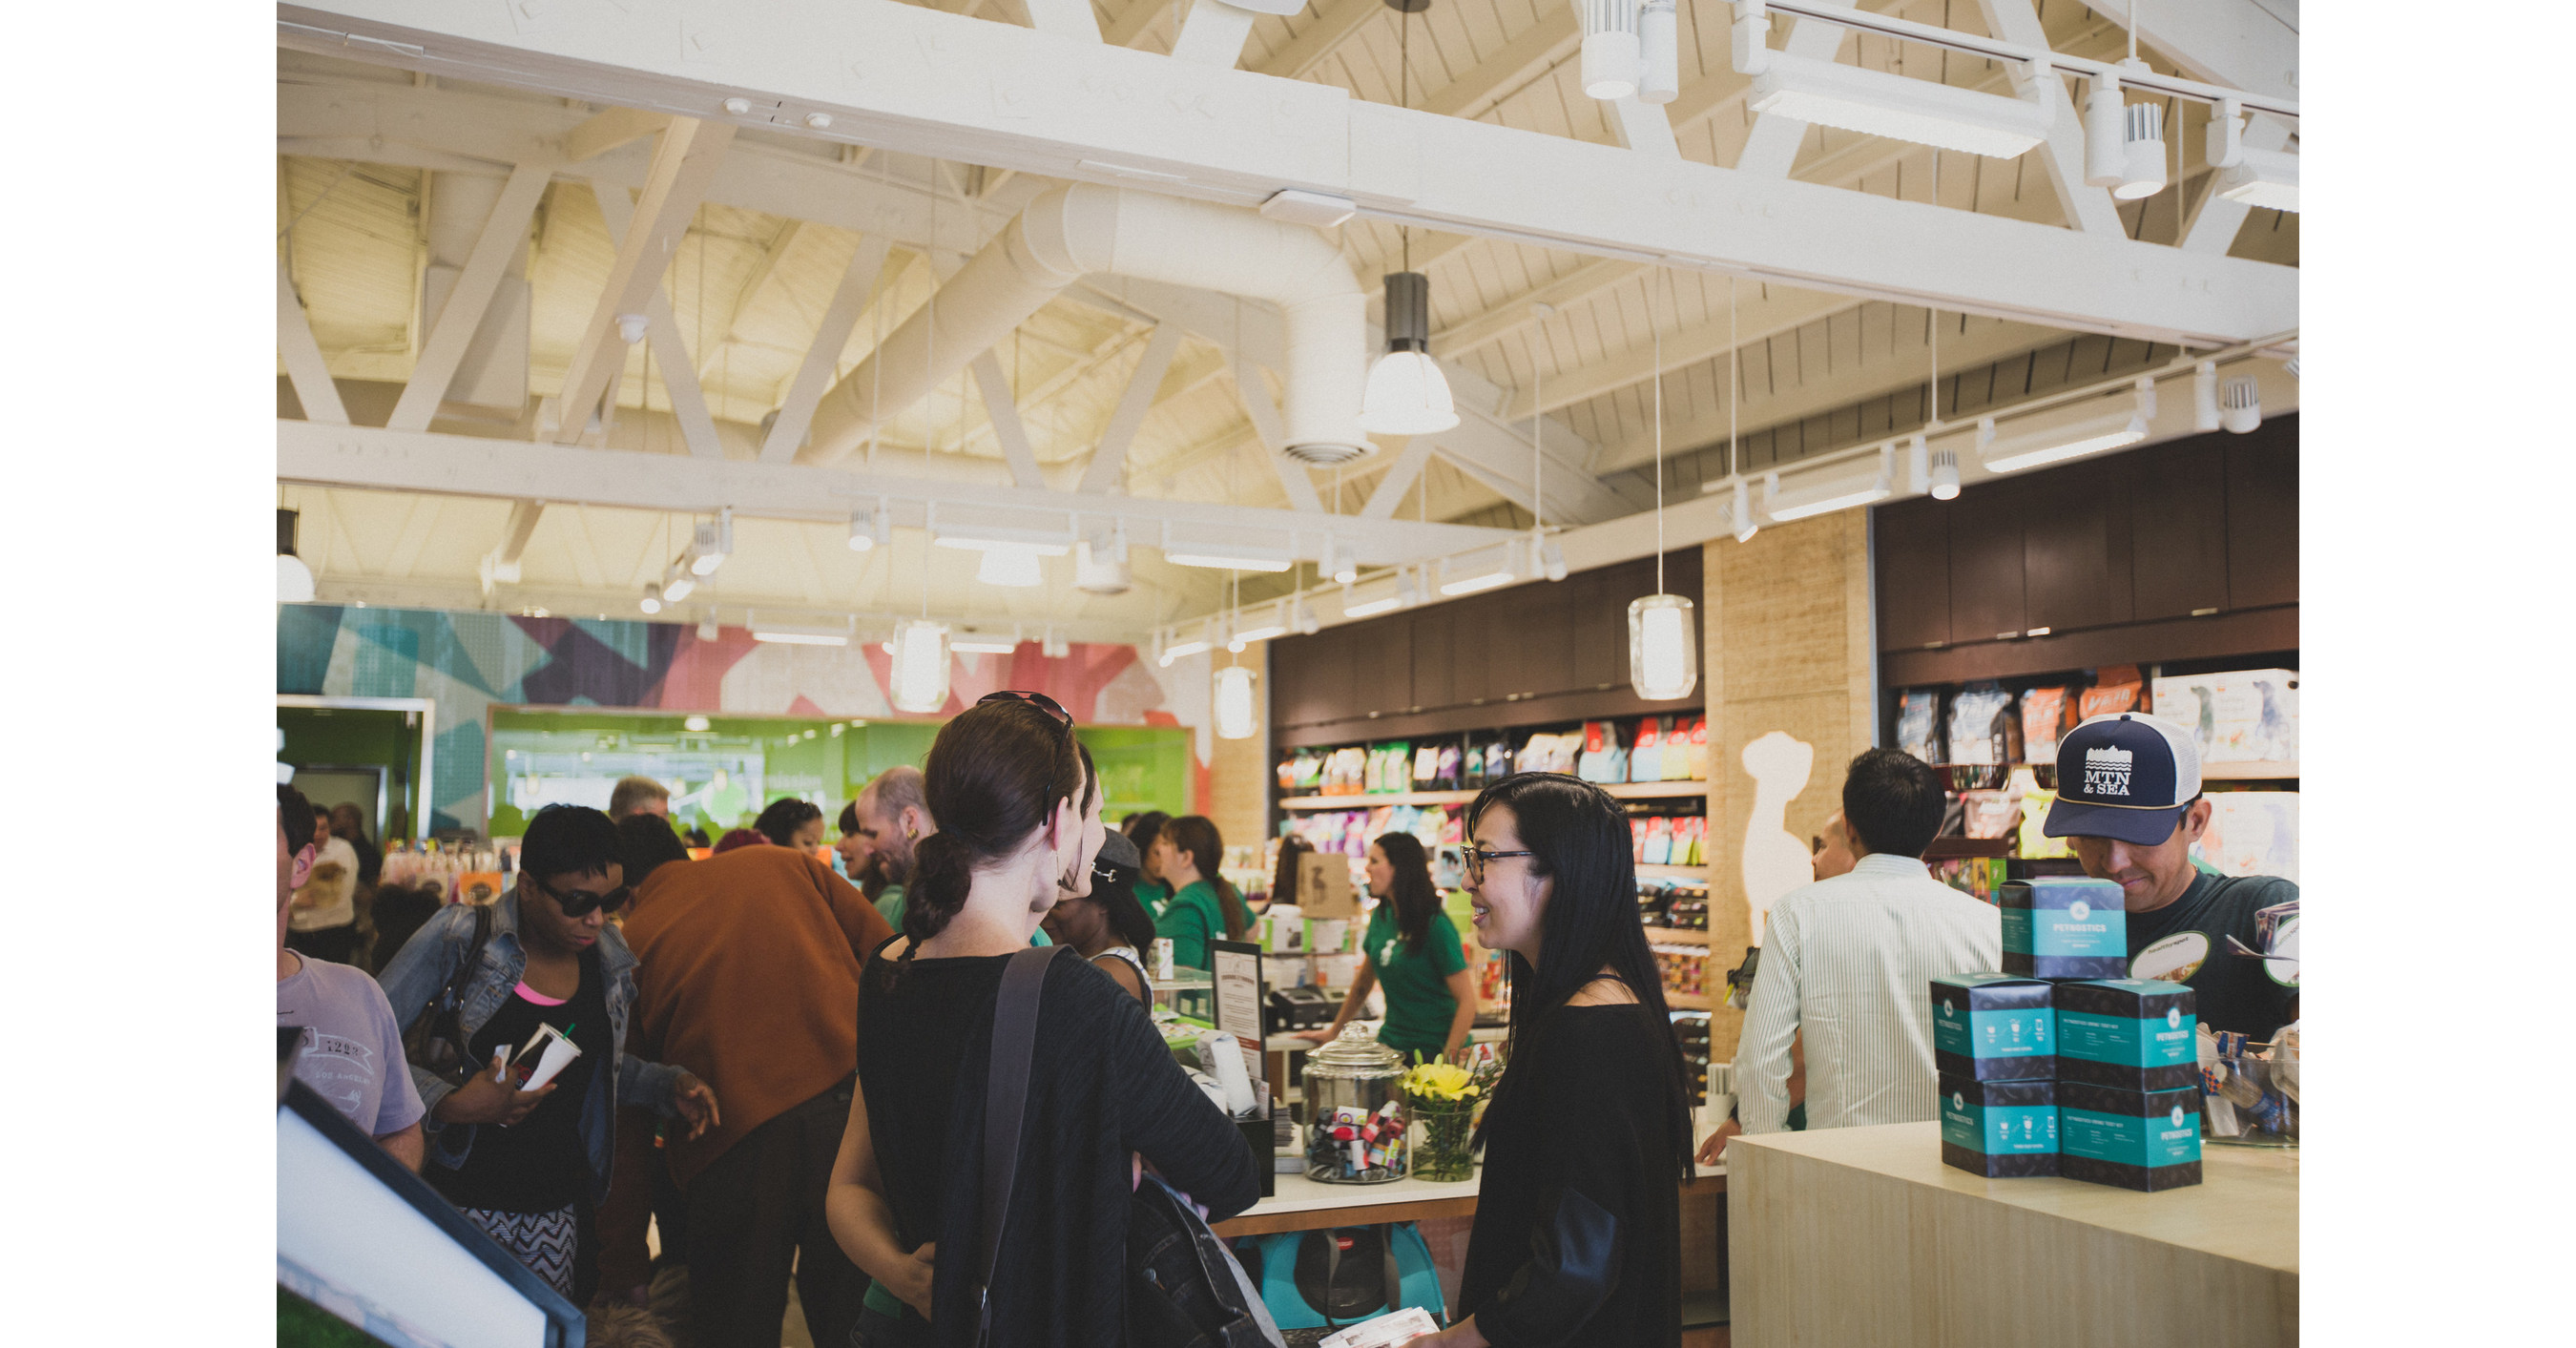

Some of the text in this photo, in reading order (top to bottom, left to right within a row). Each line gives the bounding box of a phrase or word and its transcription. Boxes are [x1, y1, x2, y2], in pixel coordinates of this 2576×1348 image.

[2084, 770, 2131, 785] MTN
[2083, 783, 2130, 796] & SEA
[2052, 923, 2107, 933] PETNOSTICS
[2155, 1030, 2190, 1042] PETNOSTICS
[2160, 1128, 2193, 1141] PETNOSTICS
